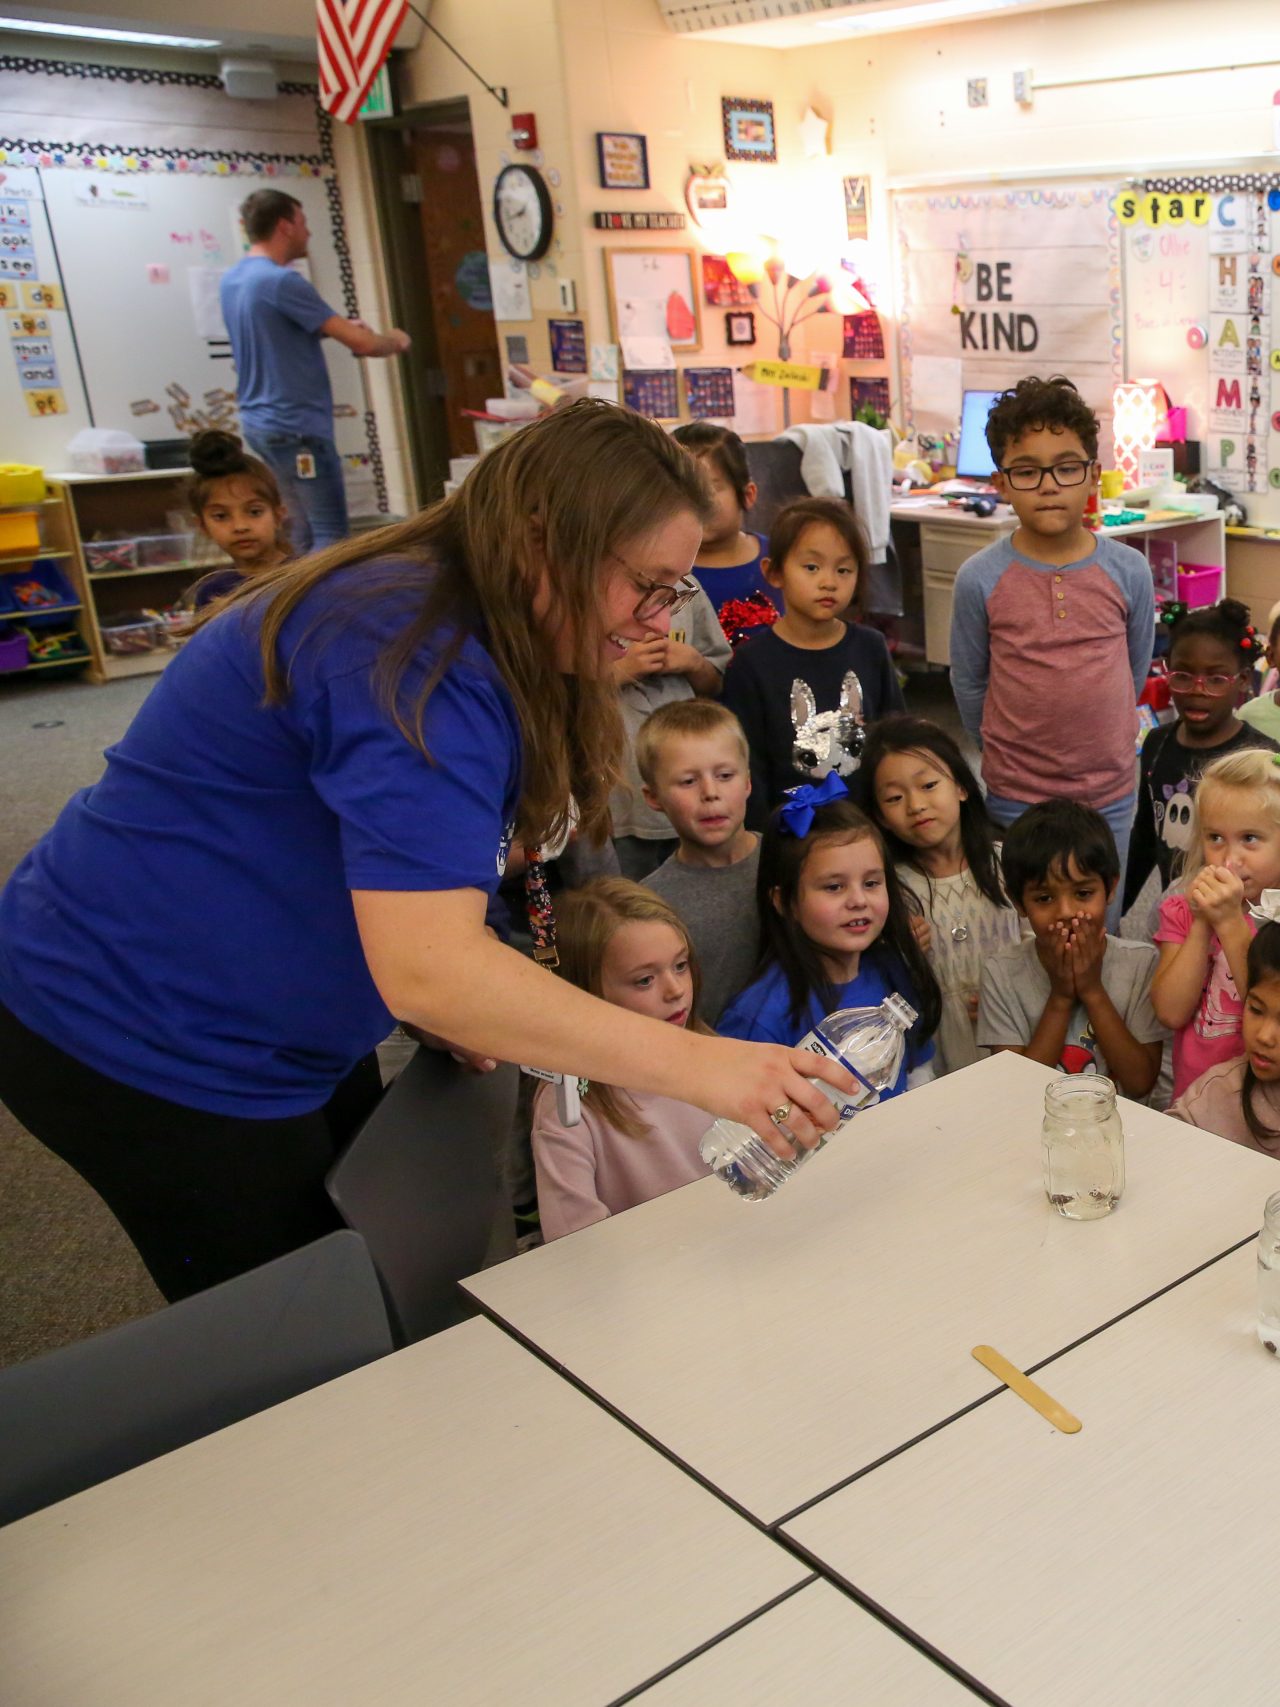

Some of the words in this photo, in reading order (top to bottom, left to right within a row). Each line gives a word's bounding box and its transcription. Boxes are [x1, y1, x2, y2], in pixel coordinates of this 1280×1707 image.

[1122, 198, 1205, 224] star
[1218, 195, 1236, 227] C
[976, 262, 1013, 302] BE
[1219, 257, 1237, 287] H
[959, 310, 1038, 352] KIND
[1219, 319, 1240, 348] A
[1216, 377, 1242, 410] M
[1220, 438, 1235, 468] P
